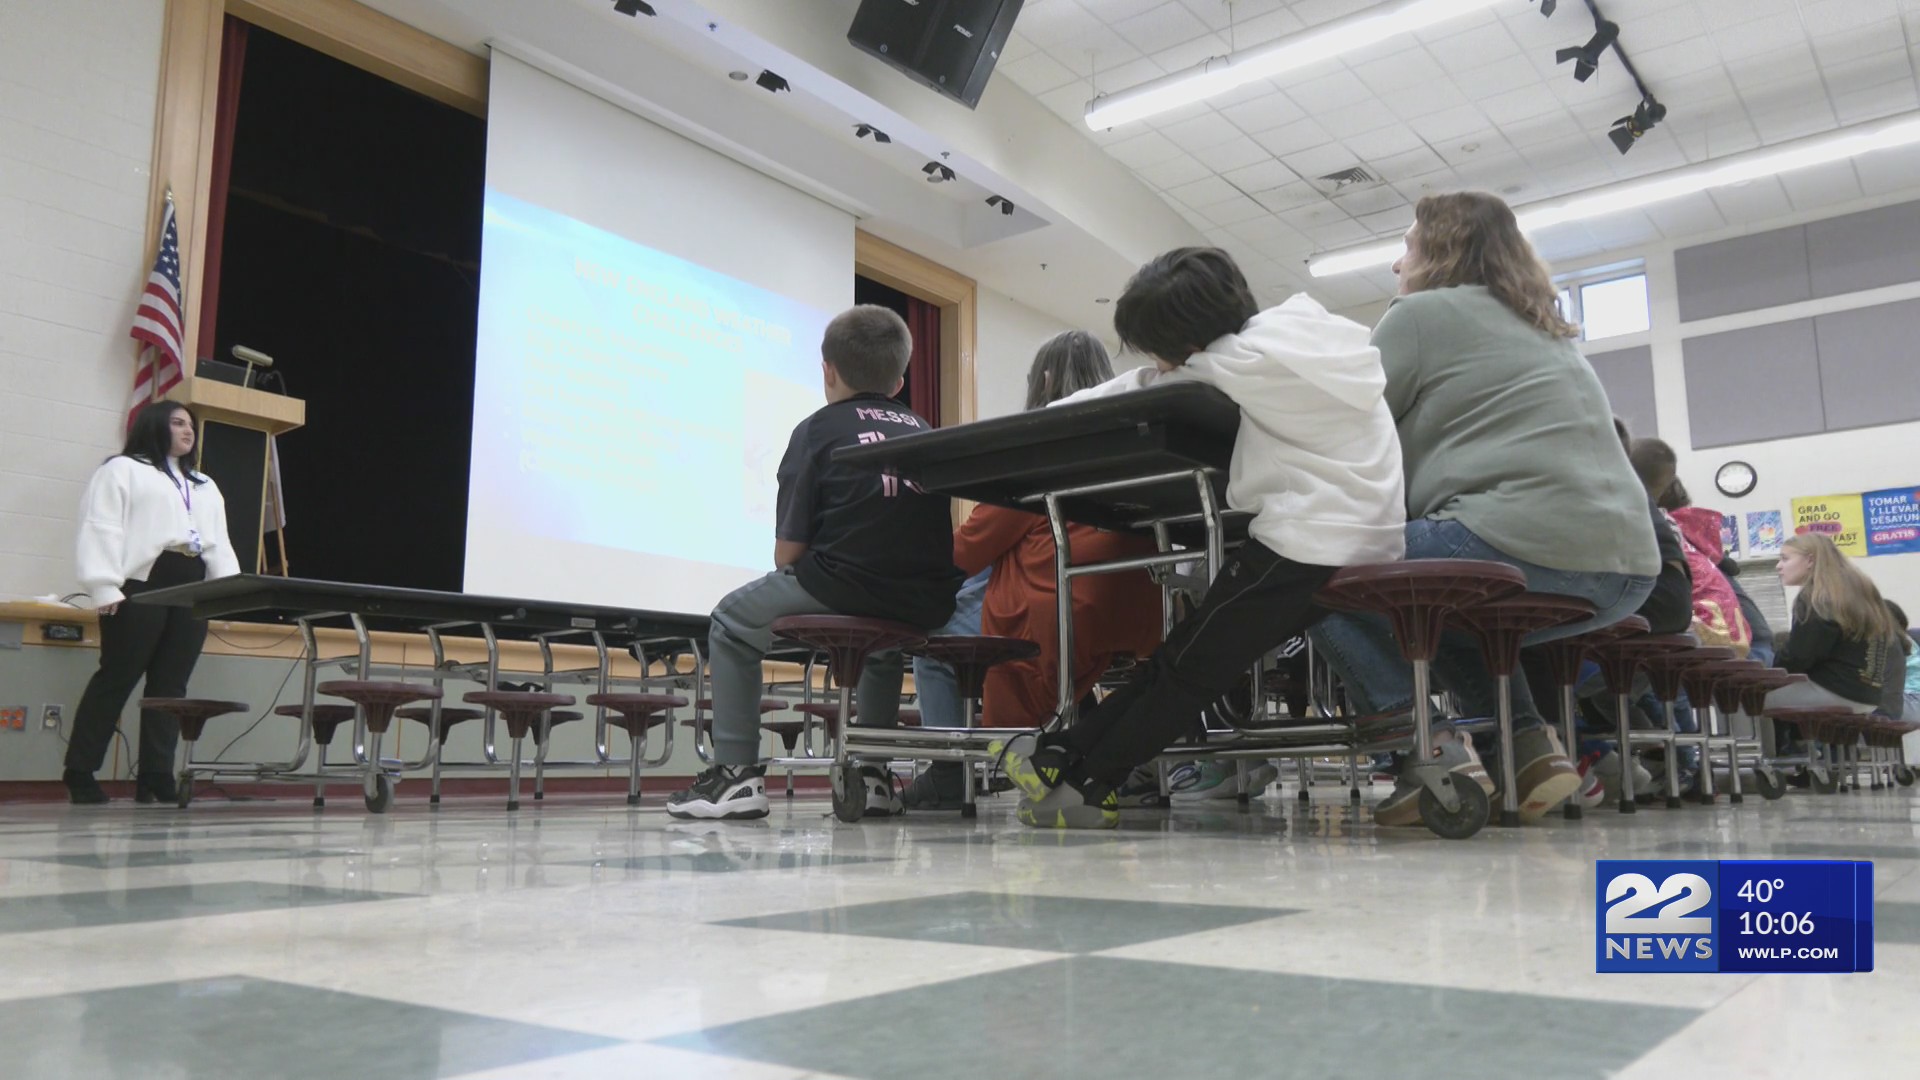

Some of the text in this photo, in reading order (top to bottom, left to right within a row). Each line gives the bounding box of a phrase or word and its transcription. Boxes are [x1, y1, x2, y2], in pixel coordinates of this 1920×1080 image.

[574, 255, 621, 290] NEW
[856, 408, 920, 428] MESSI
[1869, 495, 1907, 507] TOMAR
[1798, 504, 1827, 514] GRAB
[1869, 504, 1919, 516] Y LLEVAR
[1799, 512, 1840, 523] AND GO
[1871, 514, 1920, 525] DESAYUN
[1810, 523, 1838, 532] FREE
[1874, 529, 1915, 541] GRATIS
